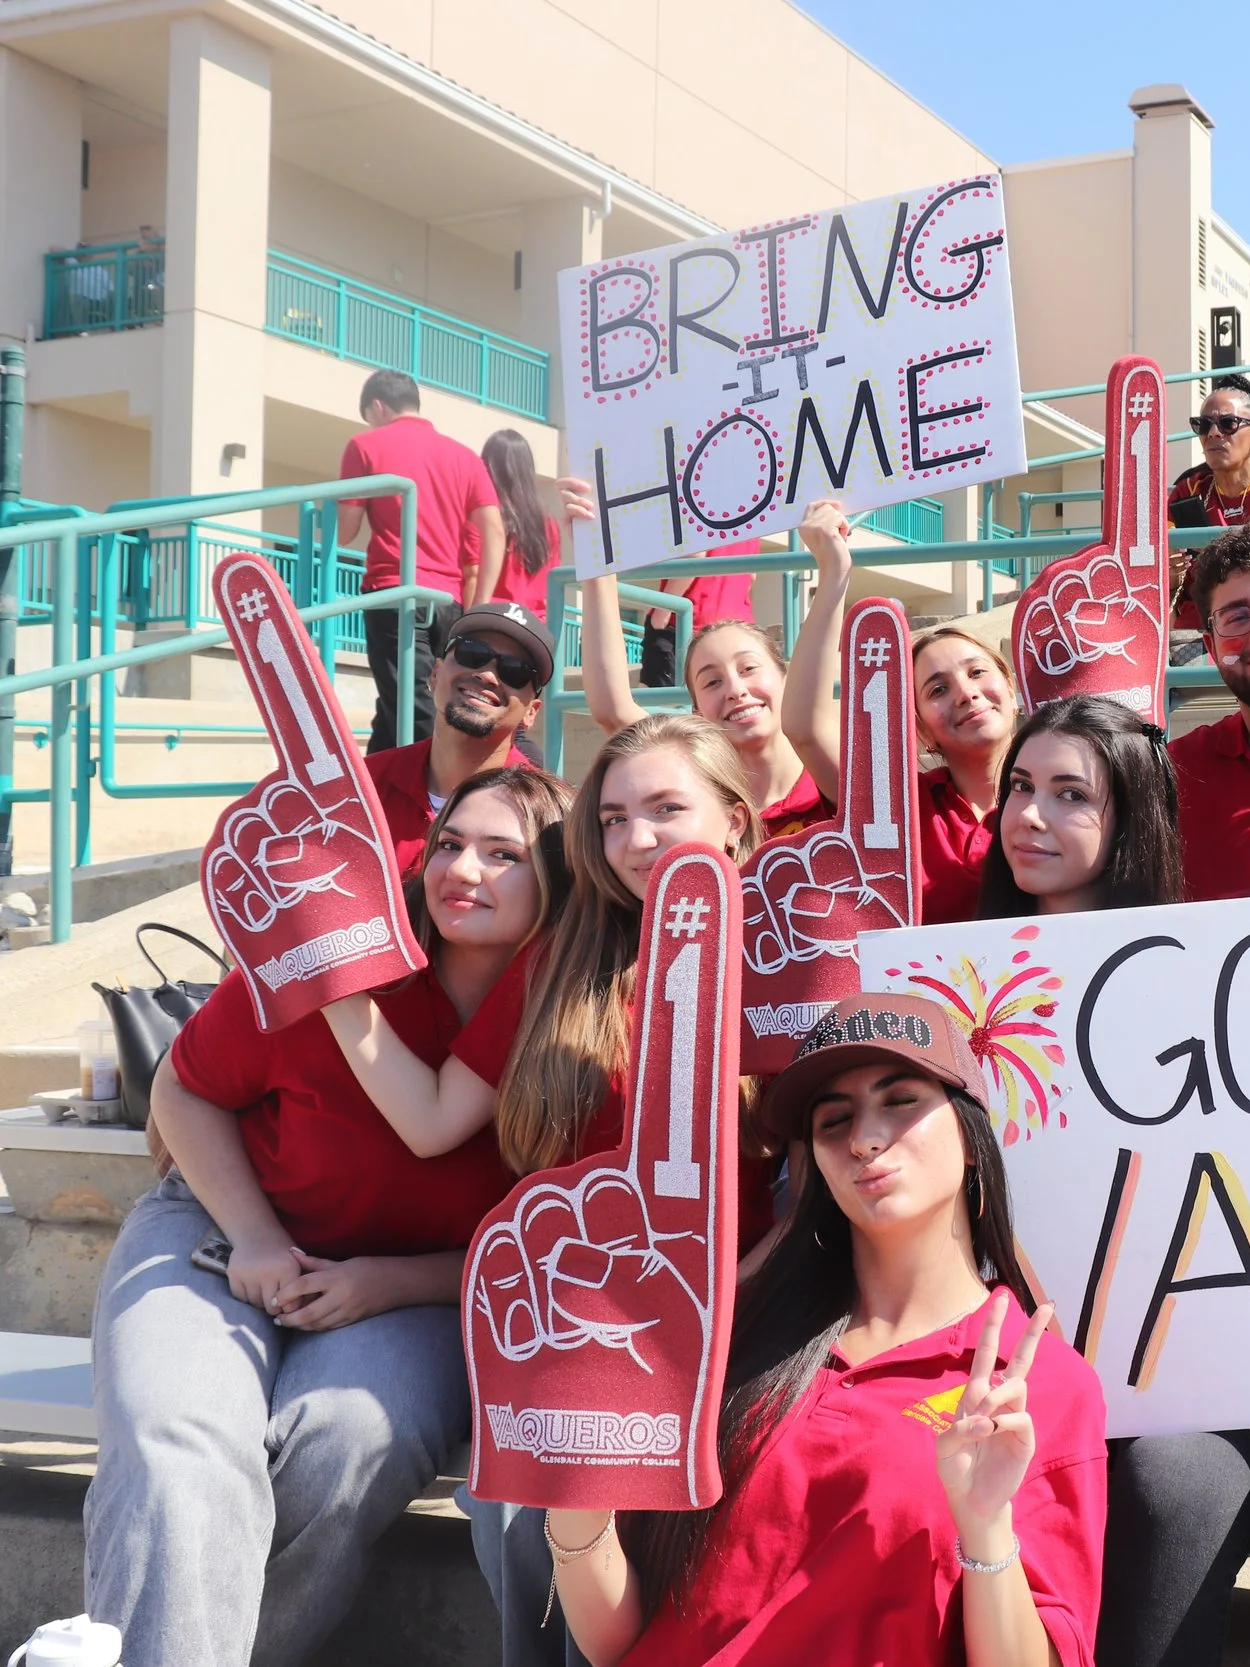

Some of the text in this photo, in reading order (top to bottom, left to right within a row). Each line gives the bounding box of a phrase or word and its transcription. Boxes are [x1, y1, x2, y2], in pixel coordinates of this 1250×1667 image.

[586, 179, 1005, 394] BRING
[593, 346, 987, 565] HOME
[503, 602, 528, 626] LA
[253, 915, 391, 994] VAQUEROS
[302, 943, 396, 981] GLENDALE COMMUNITY COLLEGE
[484, 1401, 681, 1459] VAQUEROS
[539, 1455, 681, 1468] GLENDALE COMMUNITY COLLEGE
